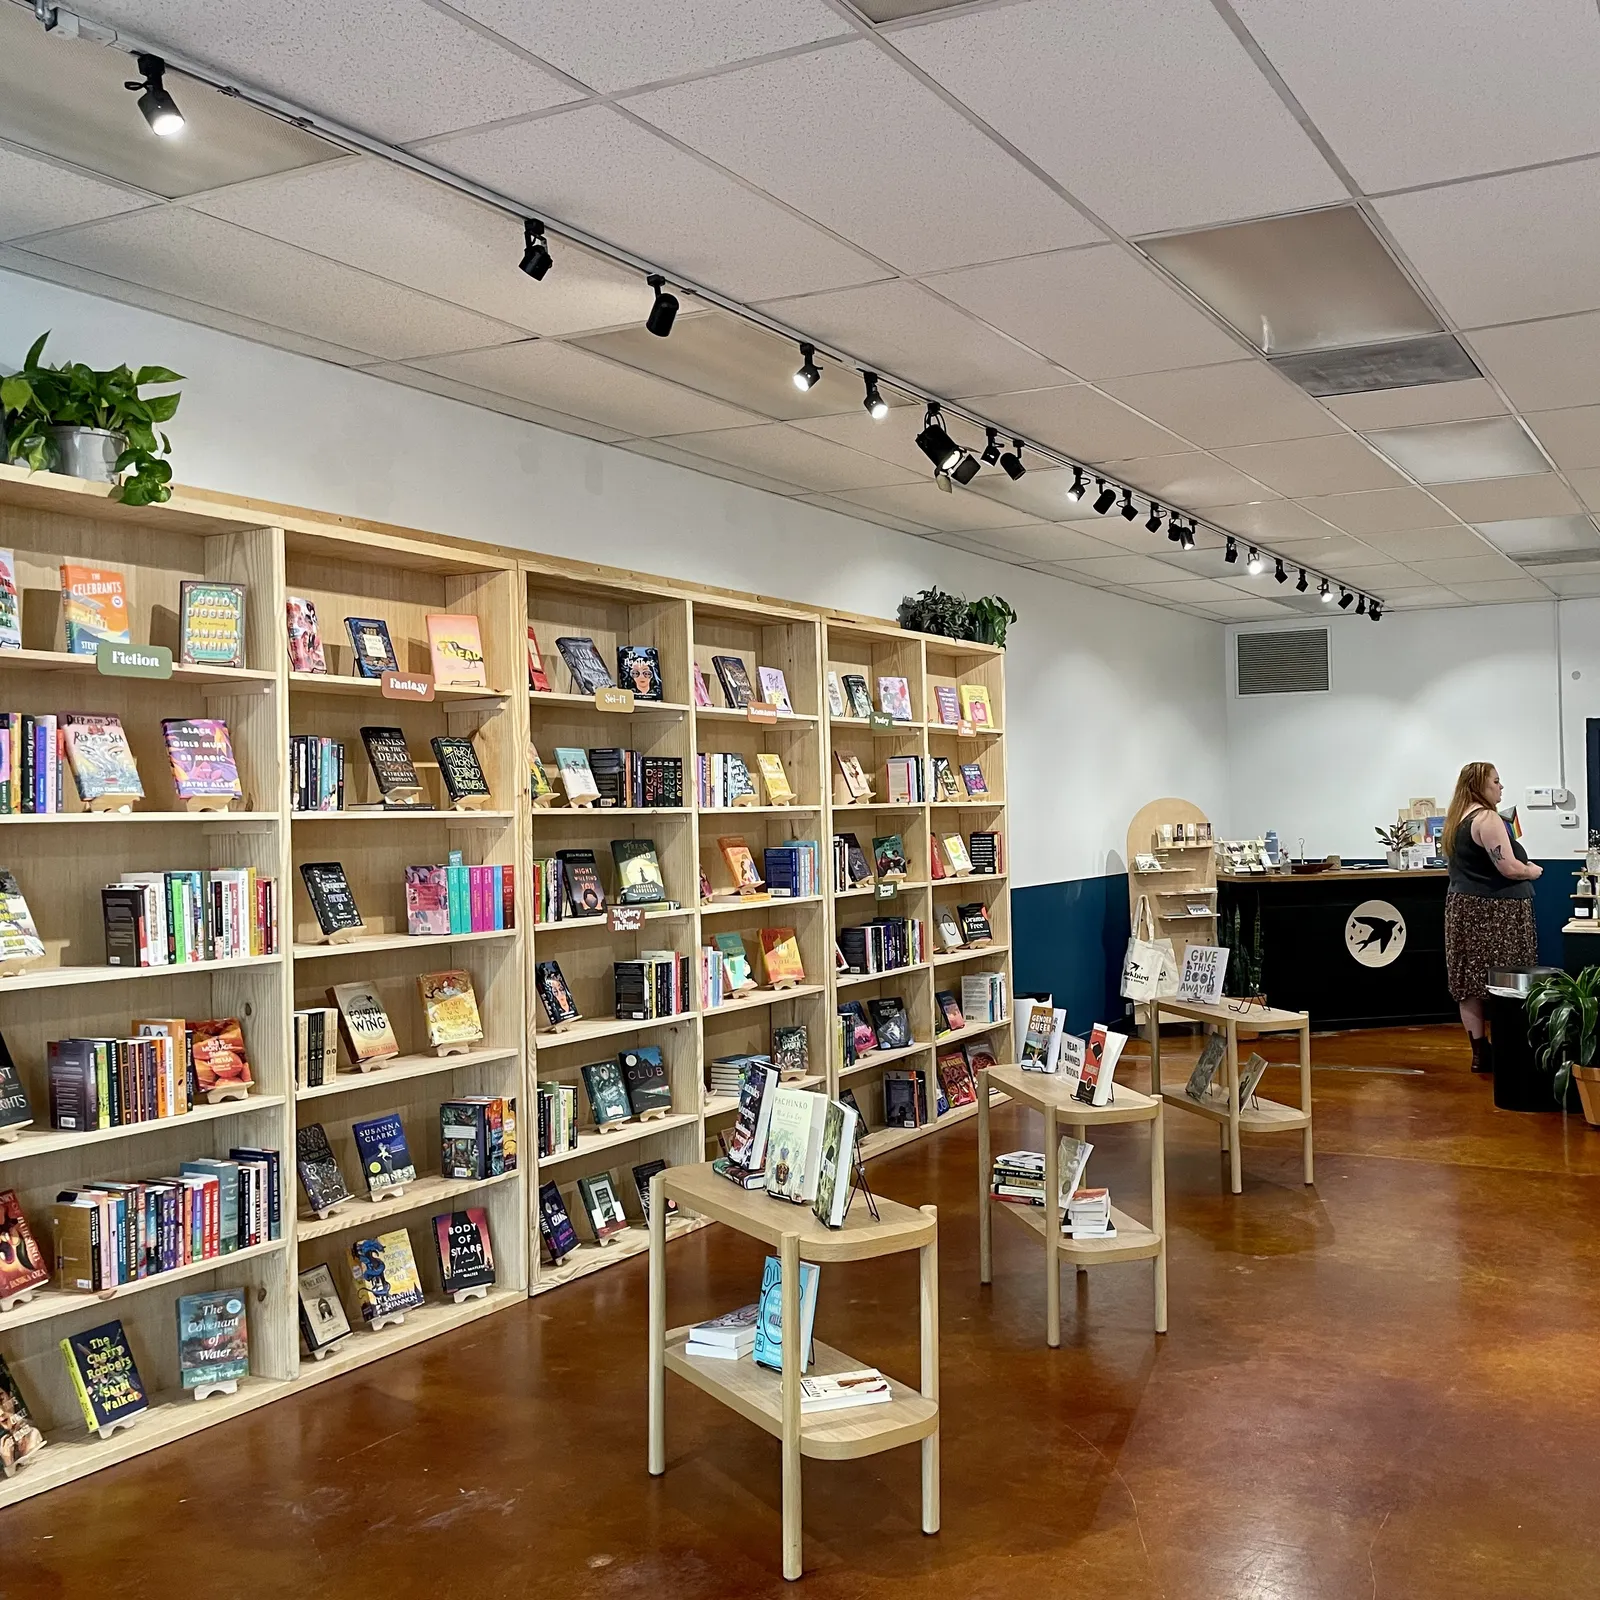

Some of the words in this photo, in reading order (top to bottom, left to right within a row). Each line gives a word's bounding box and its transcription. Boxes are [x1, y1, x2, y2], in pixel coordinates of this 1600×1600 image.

[72, 582, 122, 596] CELEBRANTS
[198, 596, 230, 606] GOLD
[187, 607, 240, 620] DIGGERS
[186, 628, 240, 640] SANJENA
[82, 641, 99, 650] STEVE
[187, 641, 237, 652] SATHIAN
[112, 650, 160, 668] Fiction
[624, 658, 655, 668] Agathas
[390, 678, 428, 695] Fantasy
[66, 715, 85, 726] DEEP
[74, 732, 88, 744] RED
[110, 733, 123, 743] SEA
[378, 753, 407, 762] DEAD
[612, 908, 642, 920] Mystery
[613, 920, 641, 931] Thriller
[349, 1007, 382, 1020] FOURTH
[1032, 1014, 1053, 1024] GENDER
[352, 1017, 386, 1032] WING
[1030, 1022, 1051, 1032] QUEER
[1066, 1041, 1078, 1053] READ
[1064, 1053, 1081, 1066] BANNED
[628, 1067, 664, 1080] CLUB
[1066, 1066, 1079, 1079] BOOKS
[775, 1097, 808, 1109] PACHINKO
[360, 1122, 400, 1137] SUSANNA
[365, 1129, 397, 1143] CLARKE
[368, 1165, 416, 1185] PIRANESI
[448, 1223, 476, 1235] BODY
[458, 1235, 471, 1244] OF
[451, 1244, 482, 1256] STARS
[385, 1295, 417, 1310] SHANNON
[202, 1304, 223, 1315] The
[188, 1317, 239, 1333] Covenant
[90, 1336, 110, 1349] The
[208, 1333, 222, 1346] of
[86, 1345, 125, 1364] Cherry
[199, 1348, 231, 1360] Water
[86, 1356, 131, 1380] Robbers
[103, 1379, 130, 1397] Sarai
[102, 1392, 140, 1412] Walker
